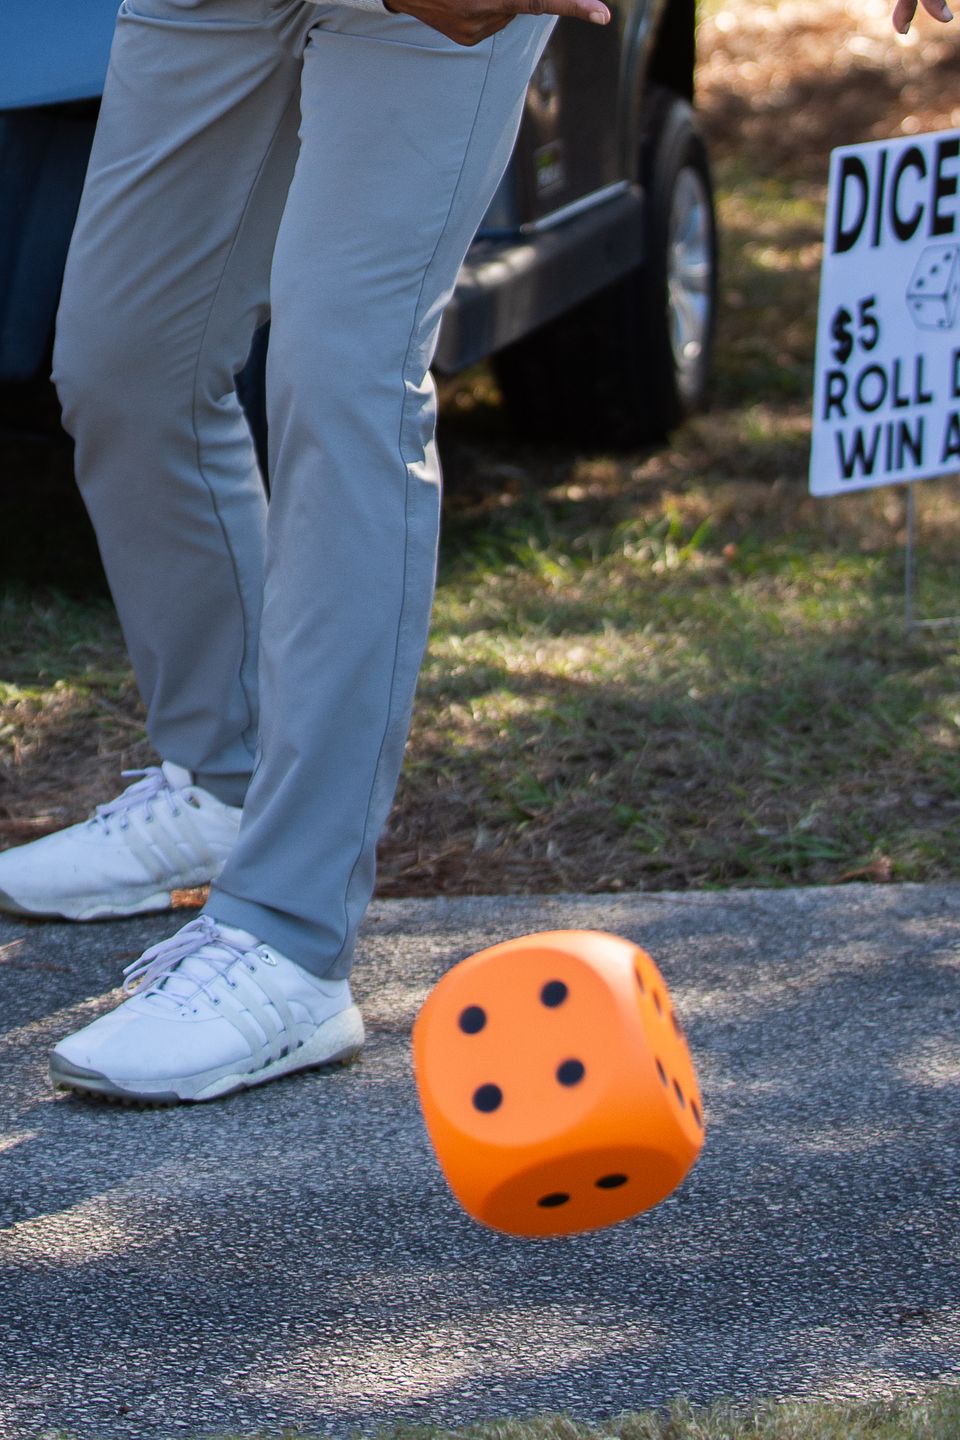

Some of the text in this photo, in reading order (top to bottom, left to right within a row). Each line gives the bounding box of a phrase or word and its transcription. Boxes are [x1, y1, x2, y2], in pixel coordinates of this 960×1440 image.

[831, 137, 960, 255] DICE
[829, 294, 880, 365] $5
[821, 353, 933, 421] ROLL
[834, 415, 924, 480] WIN
